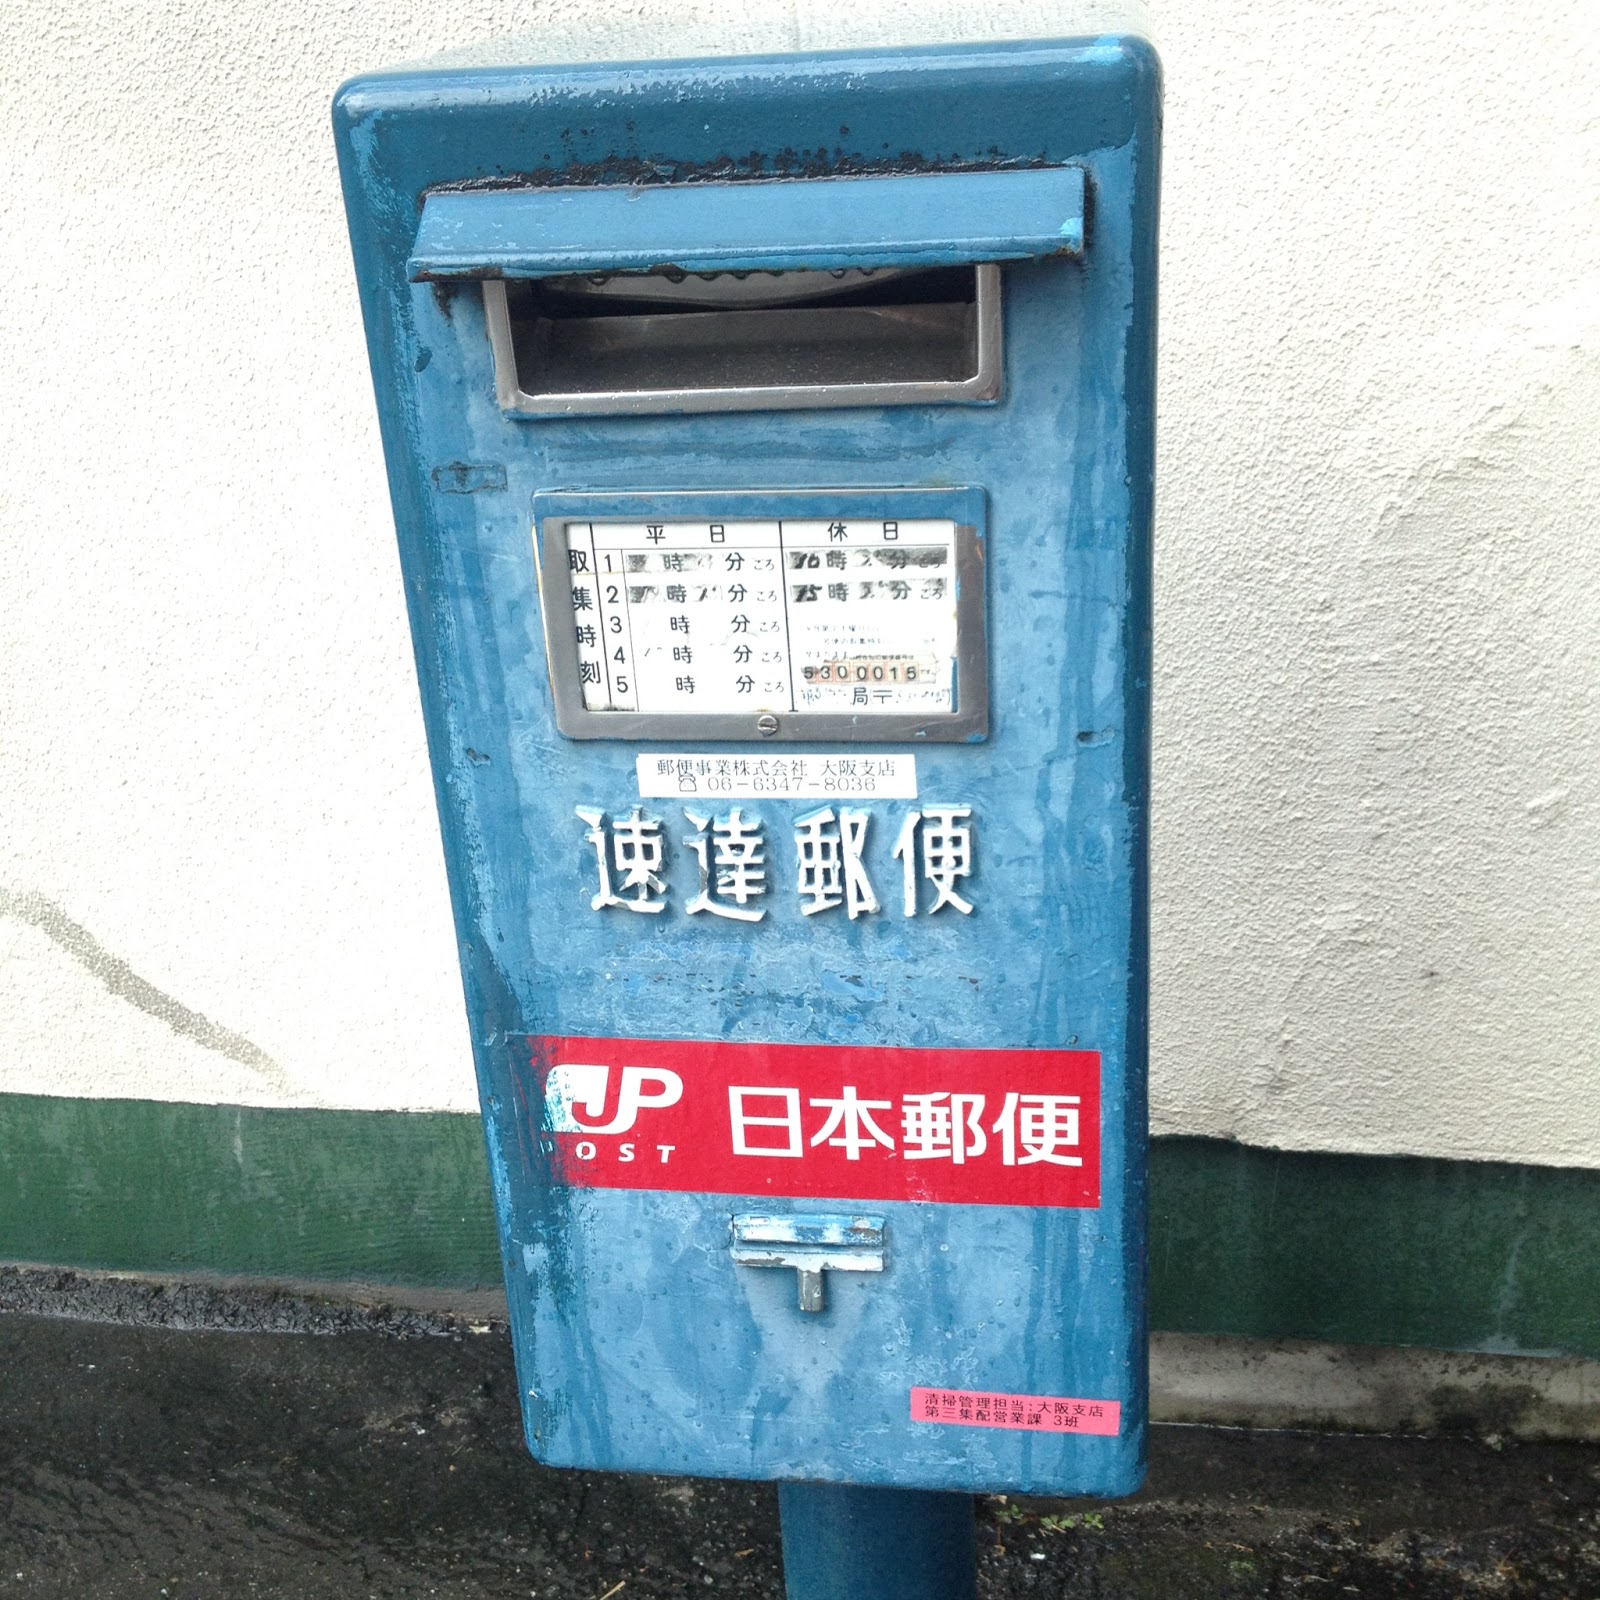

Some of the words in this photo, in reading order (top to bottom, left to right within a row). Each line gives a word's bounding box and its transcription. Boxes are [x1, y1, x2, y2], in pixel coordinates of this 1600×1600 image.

[604, 554, 613, 573] 1
[606, 585, 619, 603] 2
[569, 549, 600, 684] 取集時刻
[610, 616, 623, 633] 3
[613, 646, 625, 664] 4
[616, 676, 628, 693] 5
[657, 759, 807, 776] 郵便事業株式会社
[820, 760, 895, 776] 大阪支店
[707, 777, 876, 791] 06-6347-8036
[575, 804, 974, 922] 速達郵便
[546, 1064, 684, 1135] JP
[728, 1086, 1083, 1167] 日本郵便
[540, 1140, 676, 1163] OST
